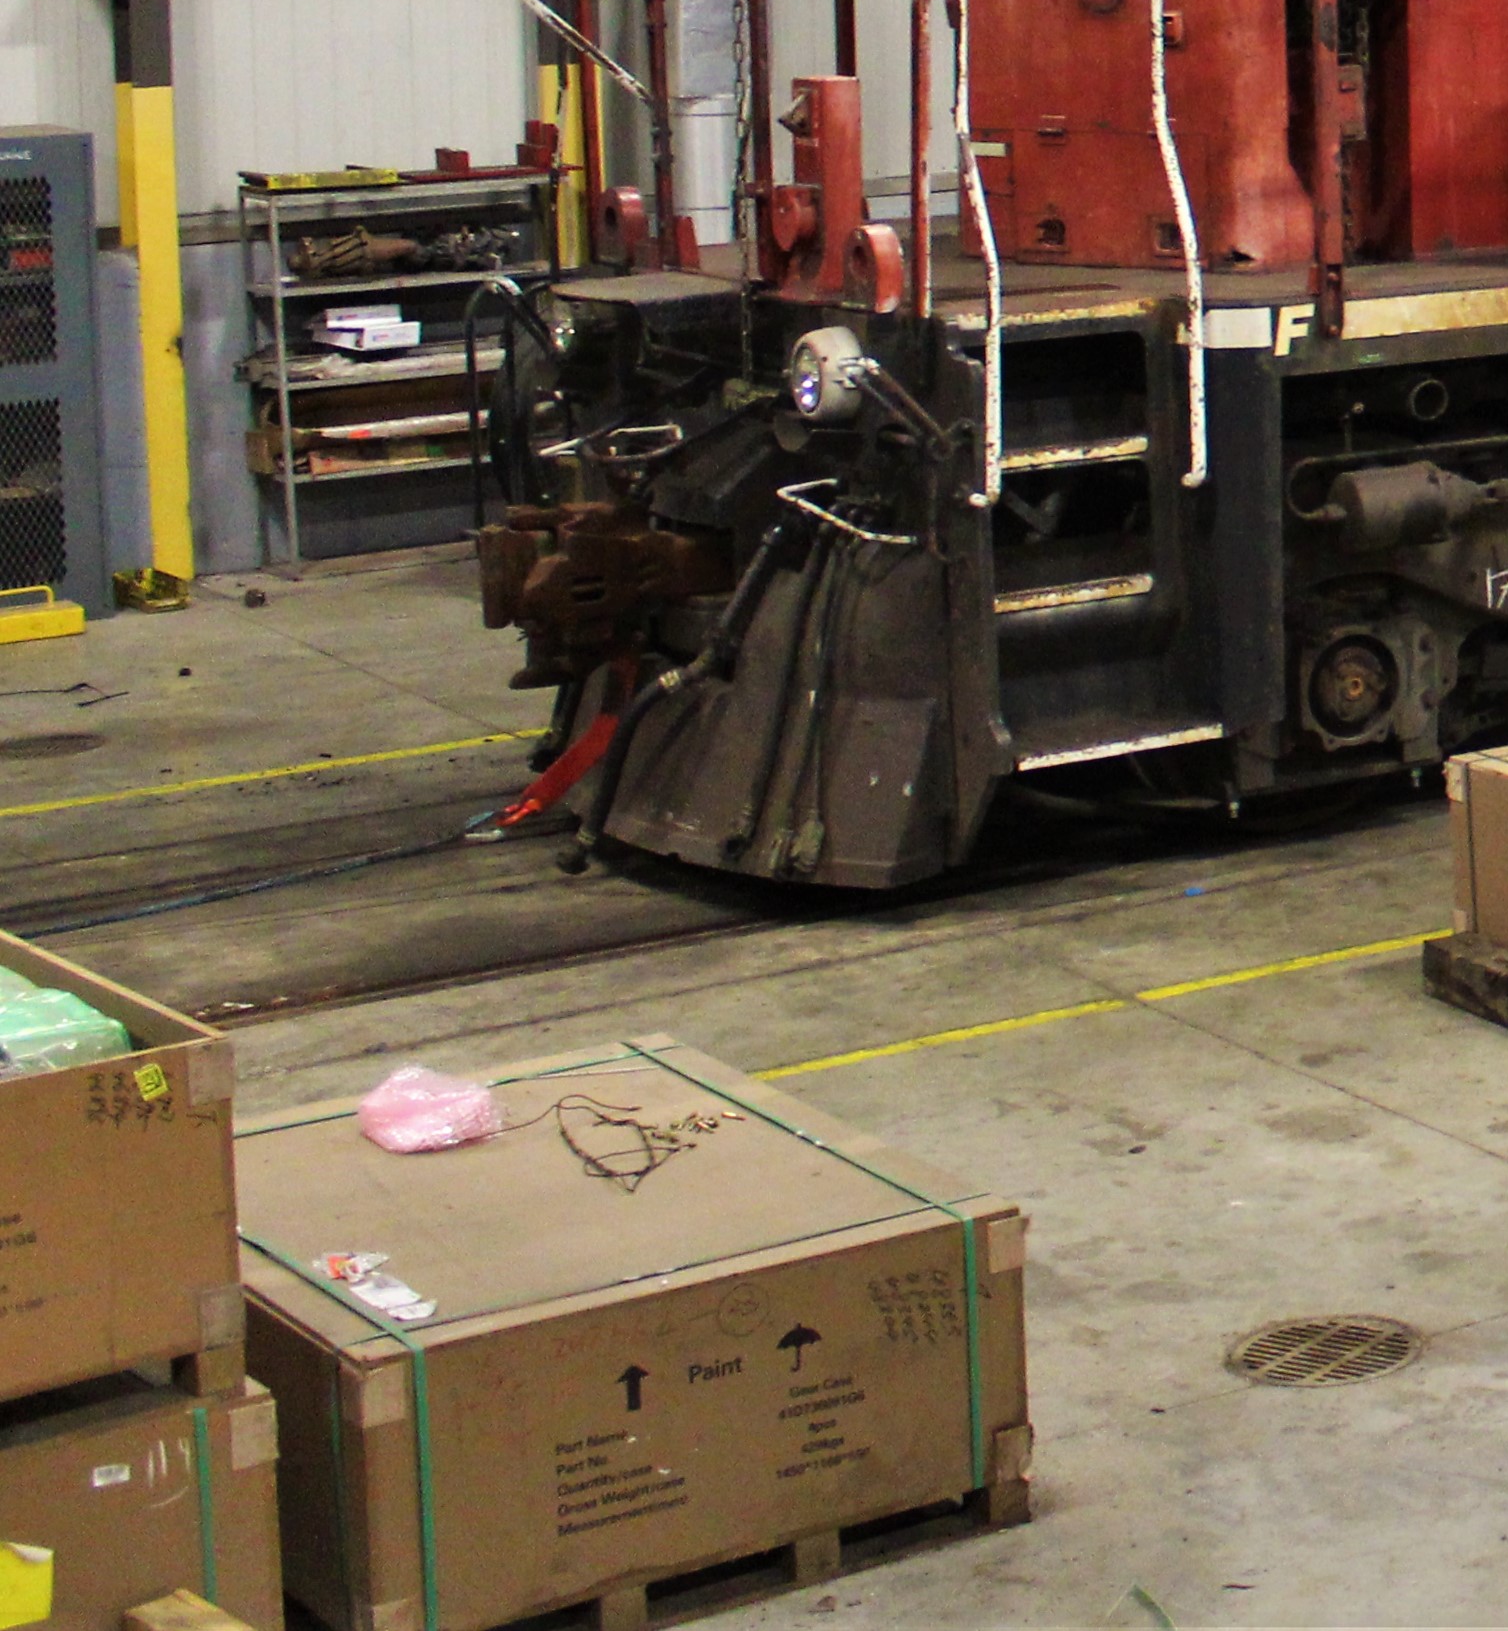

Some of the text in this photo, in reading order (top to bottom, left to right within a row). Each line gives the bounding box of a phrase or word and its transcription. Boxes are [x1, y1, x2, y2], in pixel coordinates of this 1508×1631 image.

[687, 1356, 743, 1384] Paint
[555, 1439, 583, 1455] Part
[556, 1460, 584, 1476] Part
